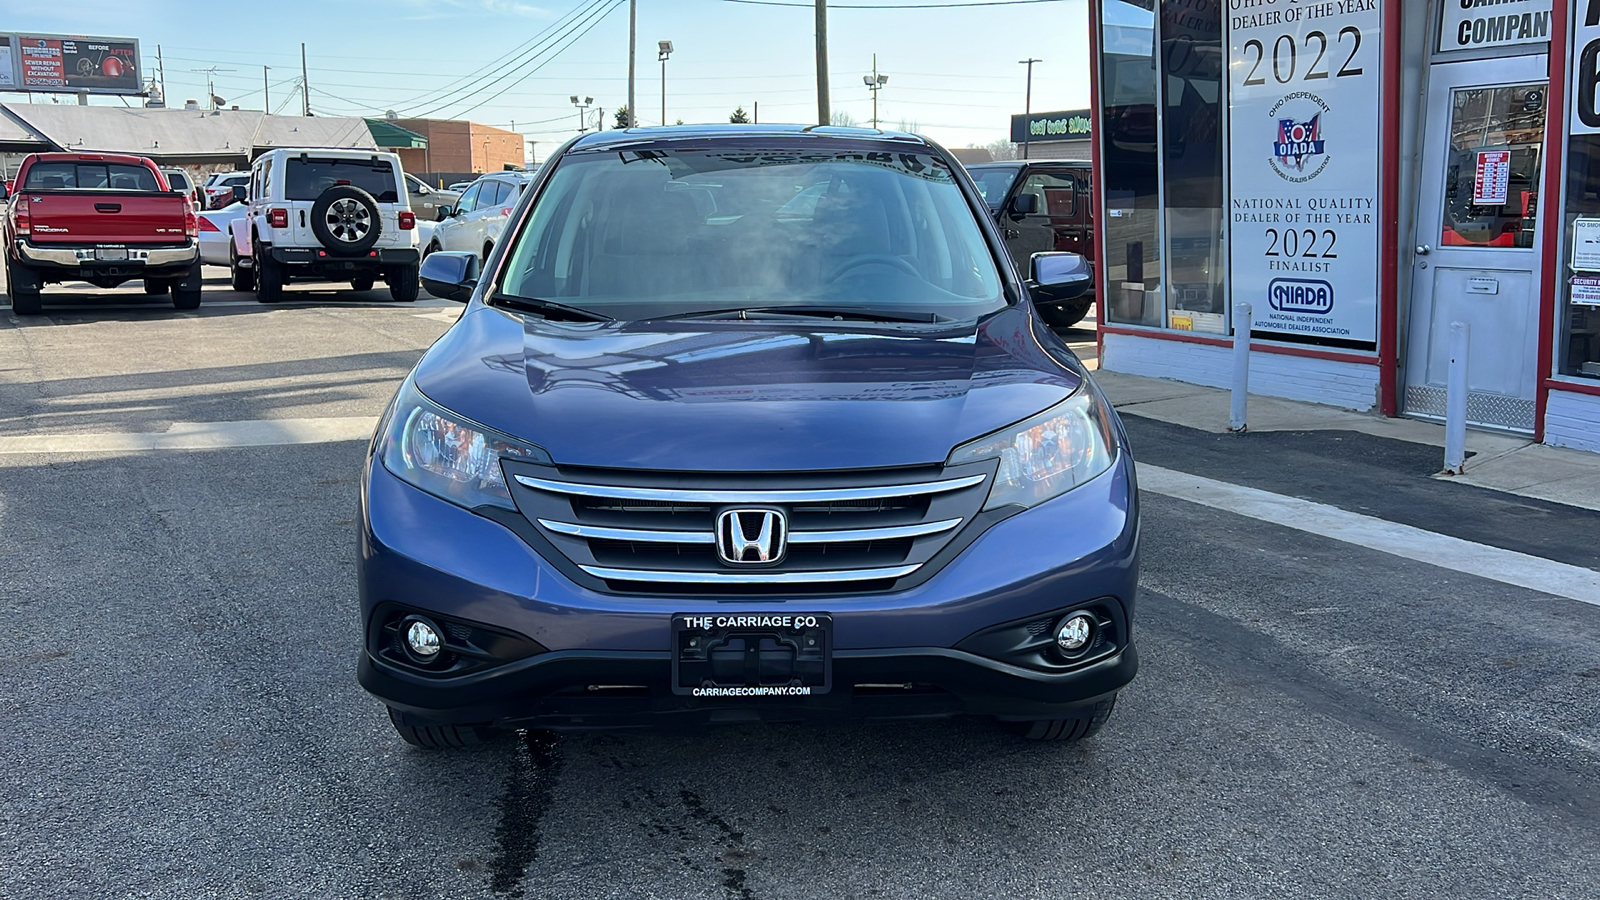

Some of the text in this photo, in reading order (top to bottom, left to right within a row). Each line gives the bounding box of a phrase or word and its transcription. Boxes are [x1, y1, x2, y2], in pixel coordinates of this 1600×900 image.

[1232, 10, 1281, 30] DEALER
[1285, 8, 1302, 22] OF
[1306, 3, 1333, 19] THE
[1337, 0, 1376, 14] YEAR
[1458, 11, 1553, 45] COMPAN
[110, 48, 133, 56] AFTER
[1242, 26, 1363, 86] 2022
[1268, 91, 1331, 118] OHIO INDEPENDENT
[1280, 141, 1316, 155] OIADA
[1268, 157, 1289, 181] AUTOMOBILE
[1308, 154, 1331, 180] ASSOCIATION
[1233, 198, 1374, 211] NATIONAL QUALITY
[1234, 213, 1371, 224] DEALER OF THE YEAR
[1265, 228, 1338, 259] 2022
[1269, 260, 1331, 272] FINALIST
[1573, 278, 1597, 286] SECURITY
[1273, 285, 1327, 308] NIADA
[1269, 313, 1334, 325] NATIONAL INDEPENDENT
[1254, 321, 1350, 335] AUTOMOBILE DEALERS ASSOCIATION
[683, 616, 819, 628] THE CARRIAGE CO.
[692, 687, 811, 697] CARRIAGECOMPANY.COM
